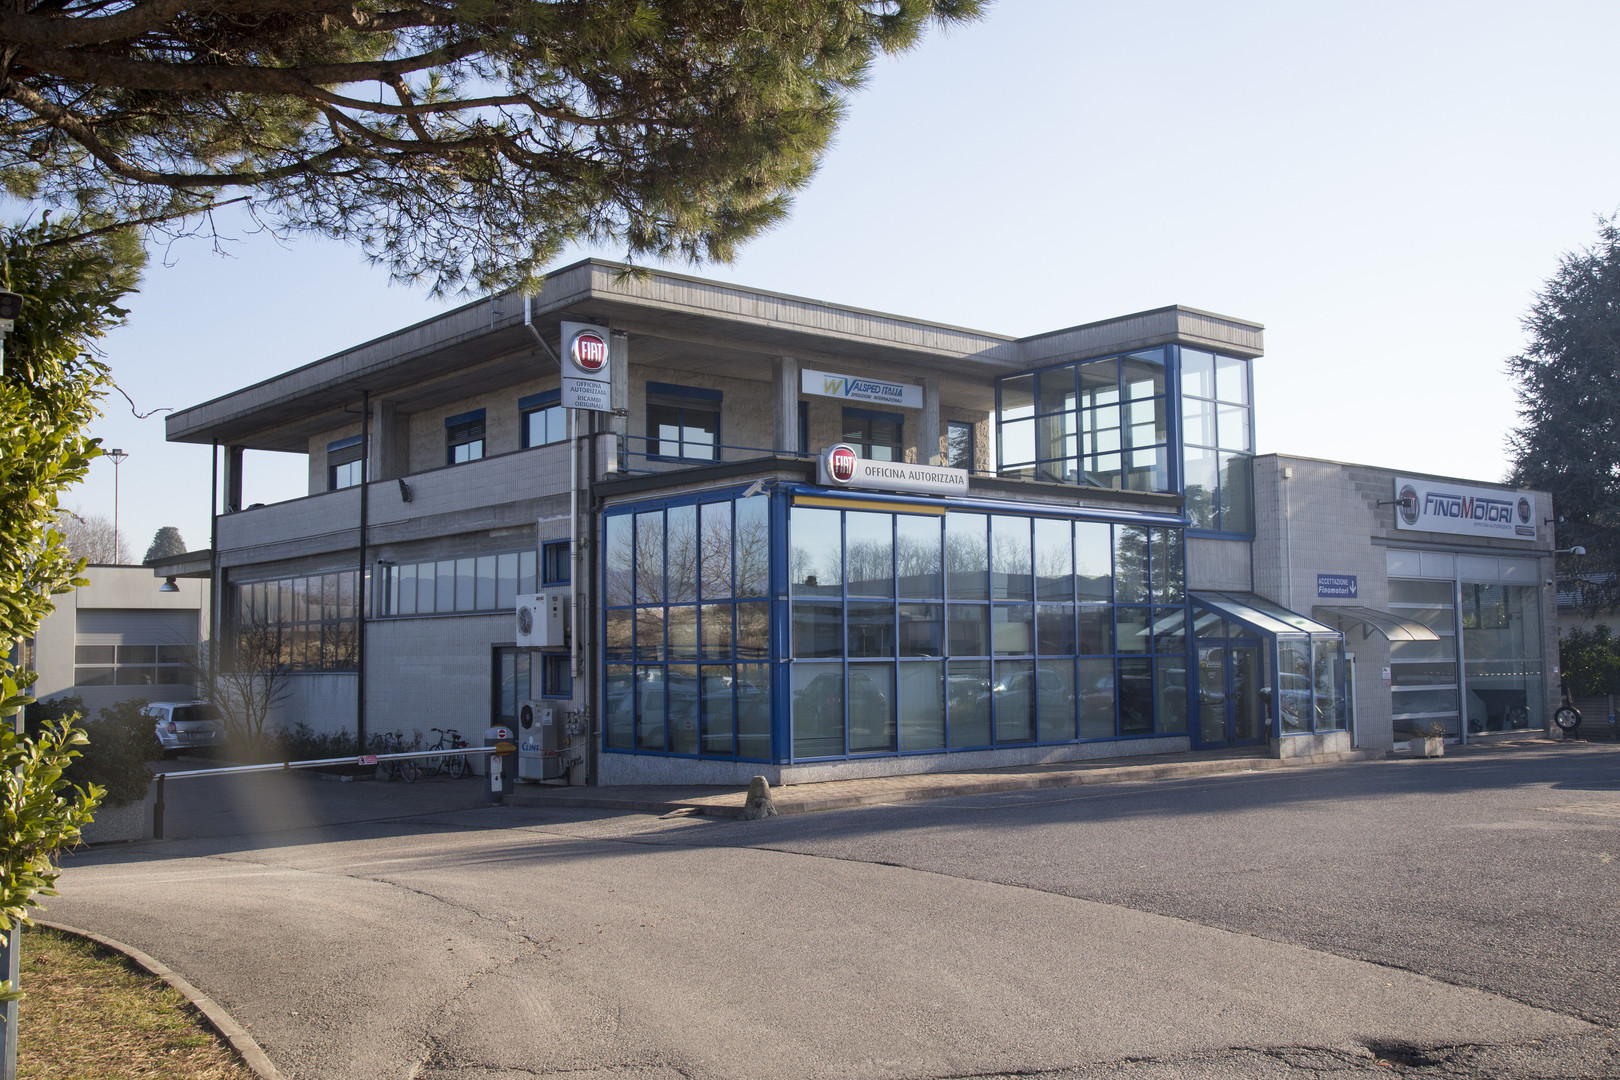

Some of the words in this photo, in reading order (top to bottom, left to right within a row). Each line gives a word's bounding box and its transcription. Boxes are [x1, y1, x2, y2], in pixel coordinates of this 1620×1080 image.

[581, 341, 602, 362] FIAT
[570, 386, 606, 395] AUTORIZZATA
[576, 381, 601, 389] OFFICINA
[881, 386, 903, 397] ITALIA
[575, 401, 603, 409] ORIGINALI
[835, 455, 853, 475] FIAT
[865, 466, 906, 480] OFFICINA
[908, 470, 965, 485] AUTORIZZATA
